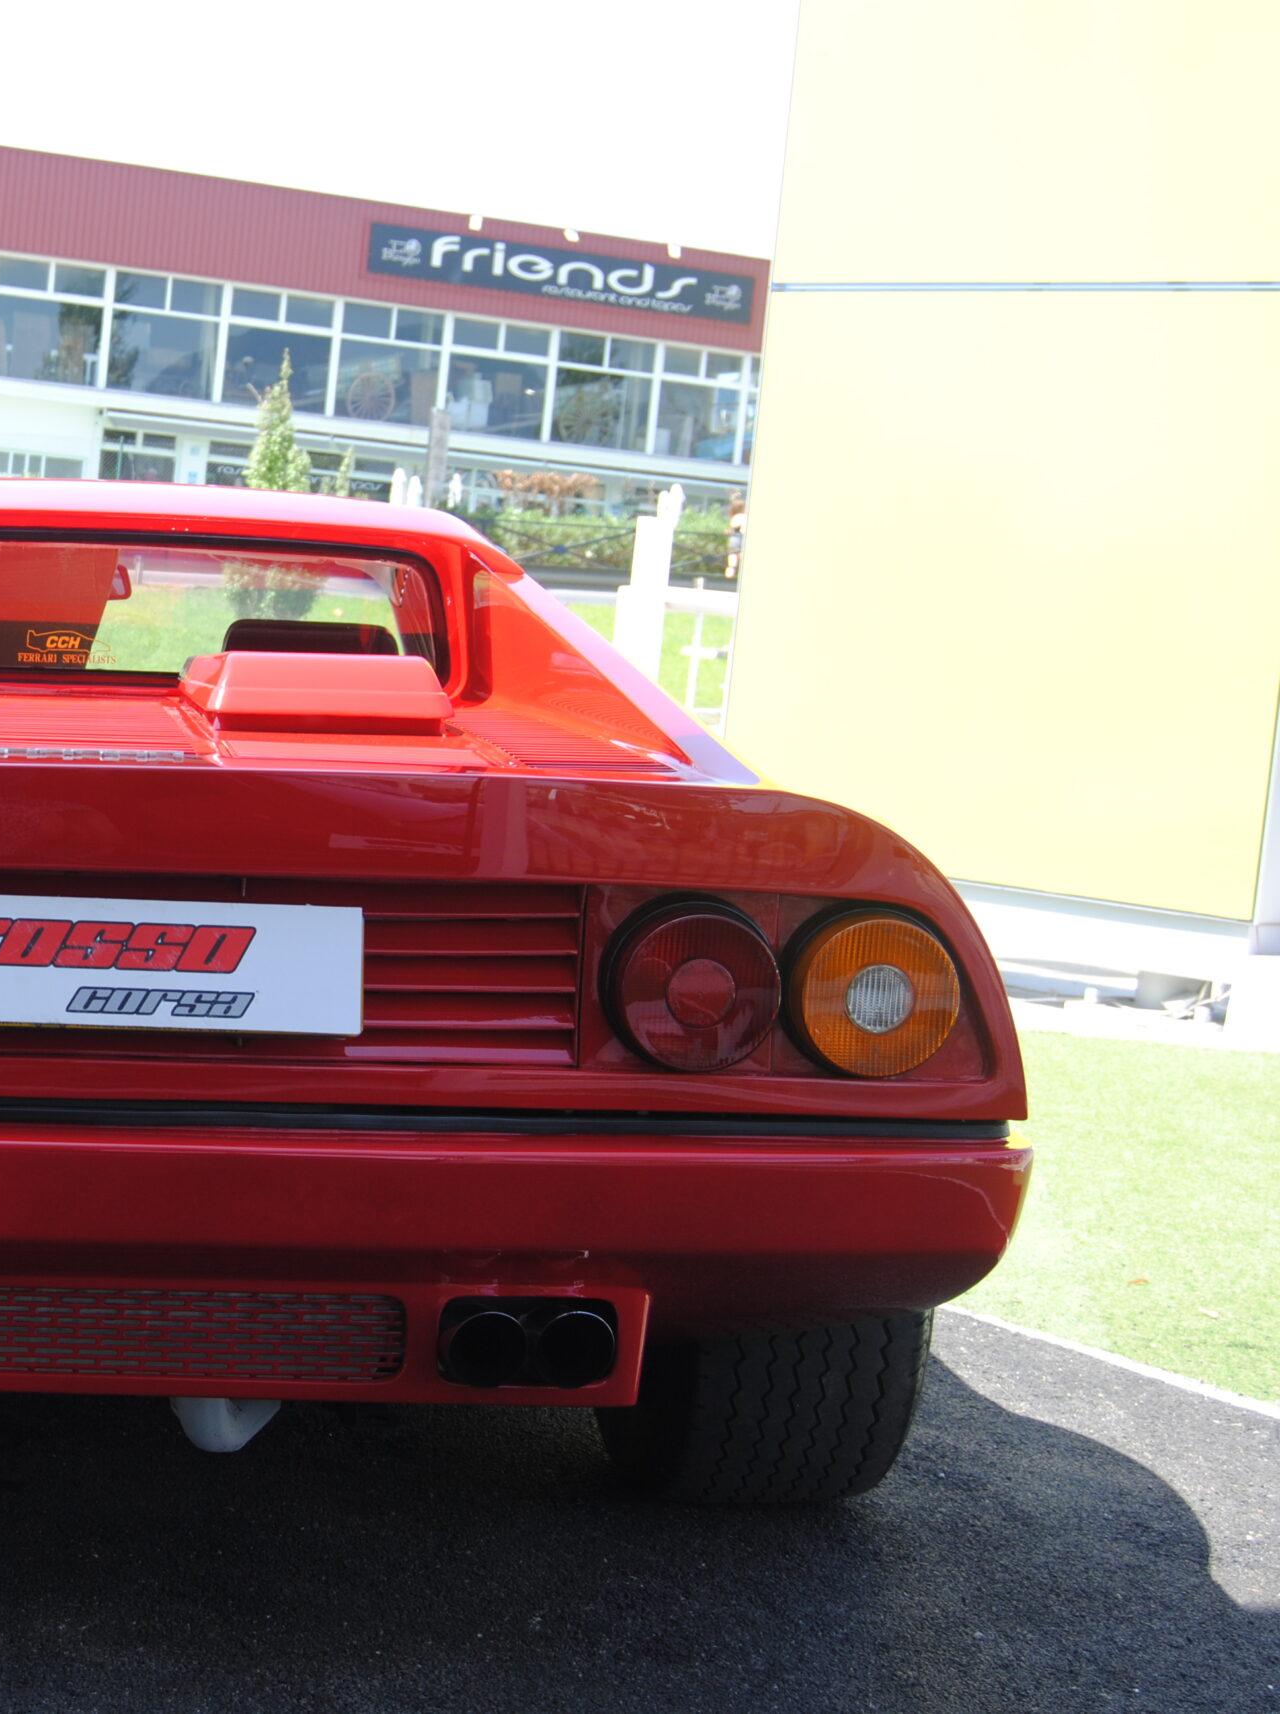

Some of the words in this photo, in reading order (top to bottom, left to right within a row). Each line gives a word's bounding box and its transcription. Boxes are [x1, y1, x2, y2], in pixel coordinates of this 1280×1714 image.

[430, 235, 698, 299] friends
[540, 284, 617, 305] restaurant
[618, 295, 650, 309] and
[46, 636, 81, 649] CCH
[17, 652, 57, 663] FERRARI
[62, 653, 116, 665] SPECIALISTS
[66, 985, 256, 1019] corsa
